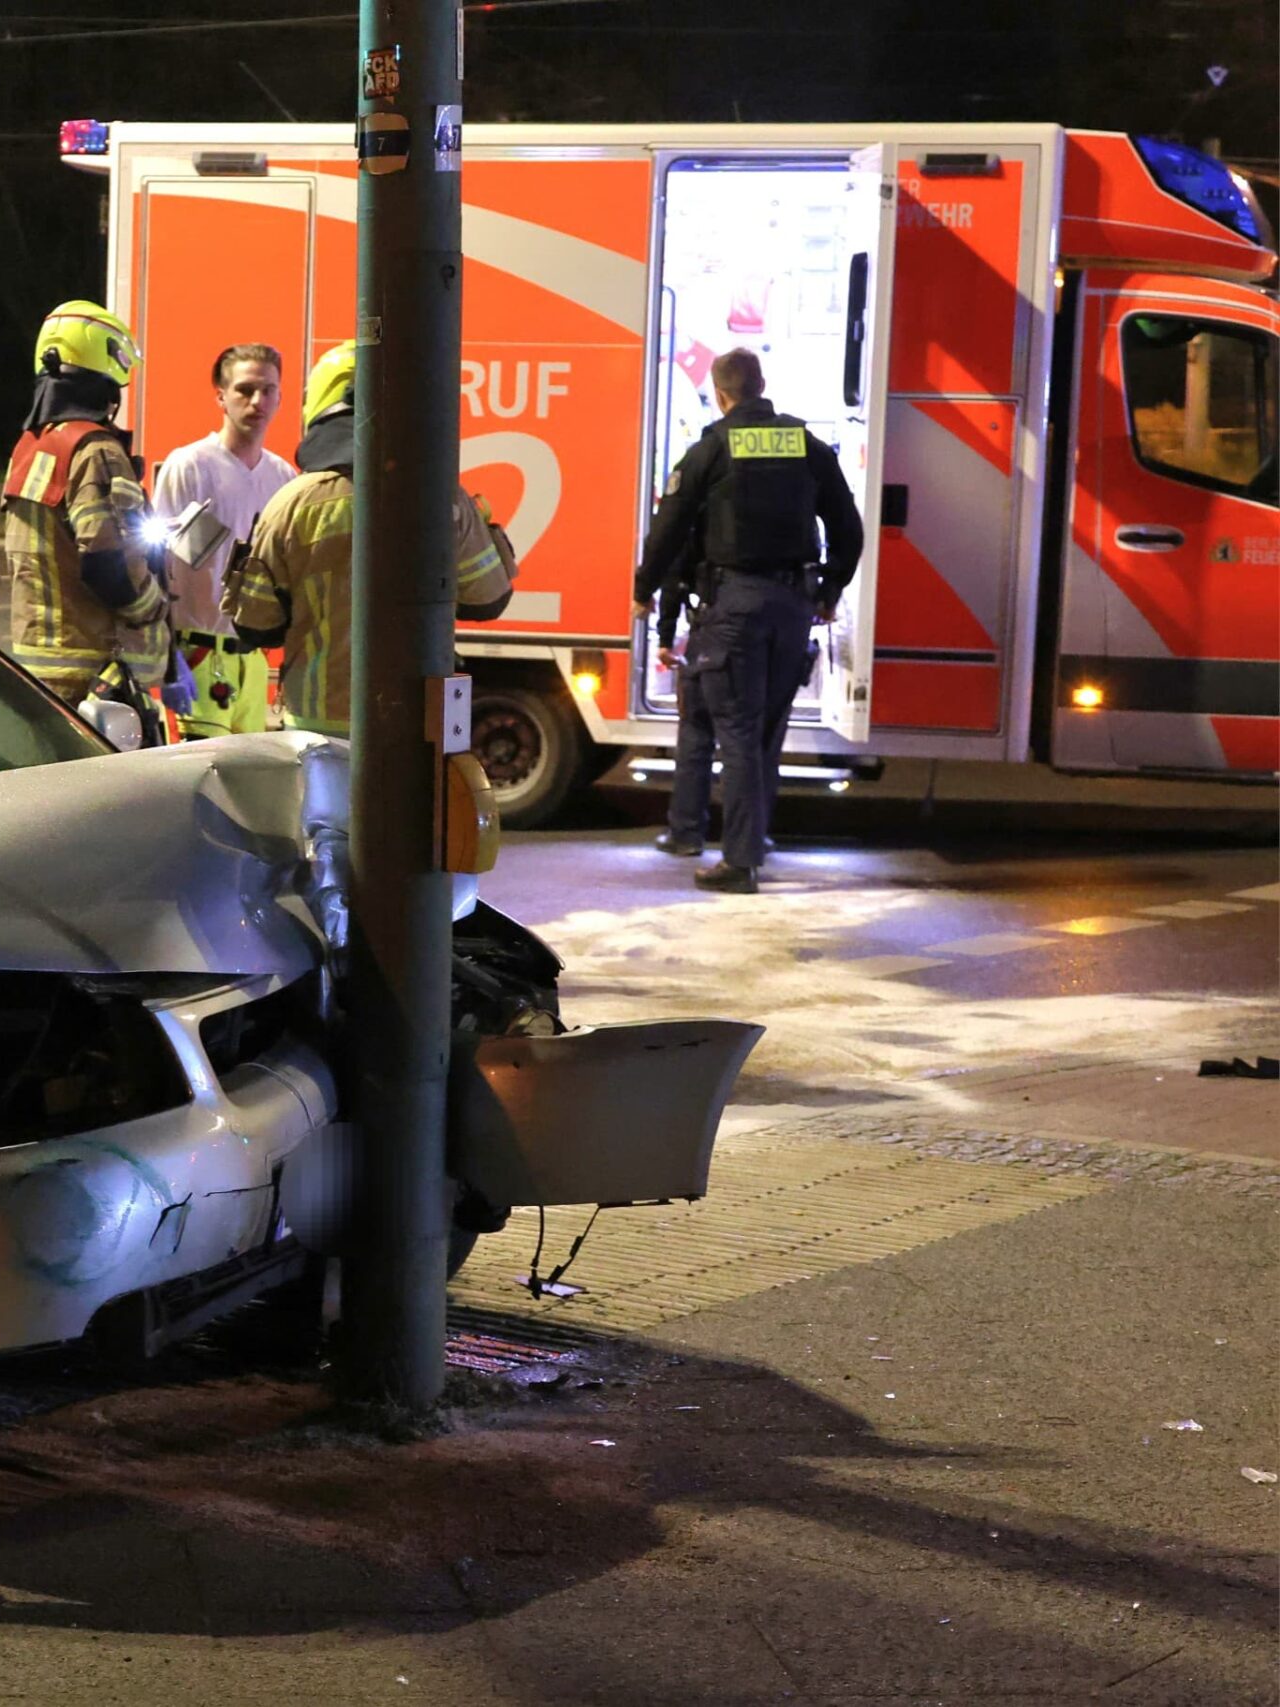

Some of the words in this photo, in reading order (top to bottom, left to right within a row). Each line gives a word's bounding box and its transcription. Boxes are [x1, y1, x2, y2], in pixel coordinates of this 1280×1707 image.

[364, 55, 398, 72] FCK
[364, 71, 400, 91] AFD
[460, 361, 571, 418] RUF
[732, 430, 803, 454] POLIZEI
[458, 431, 562, 623] 2
